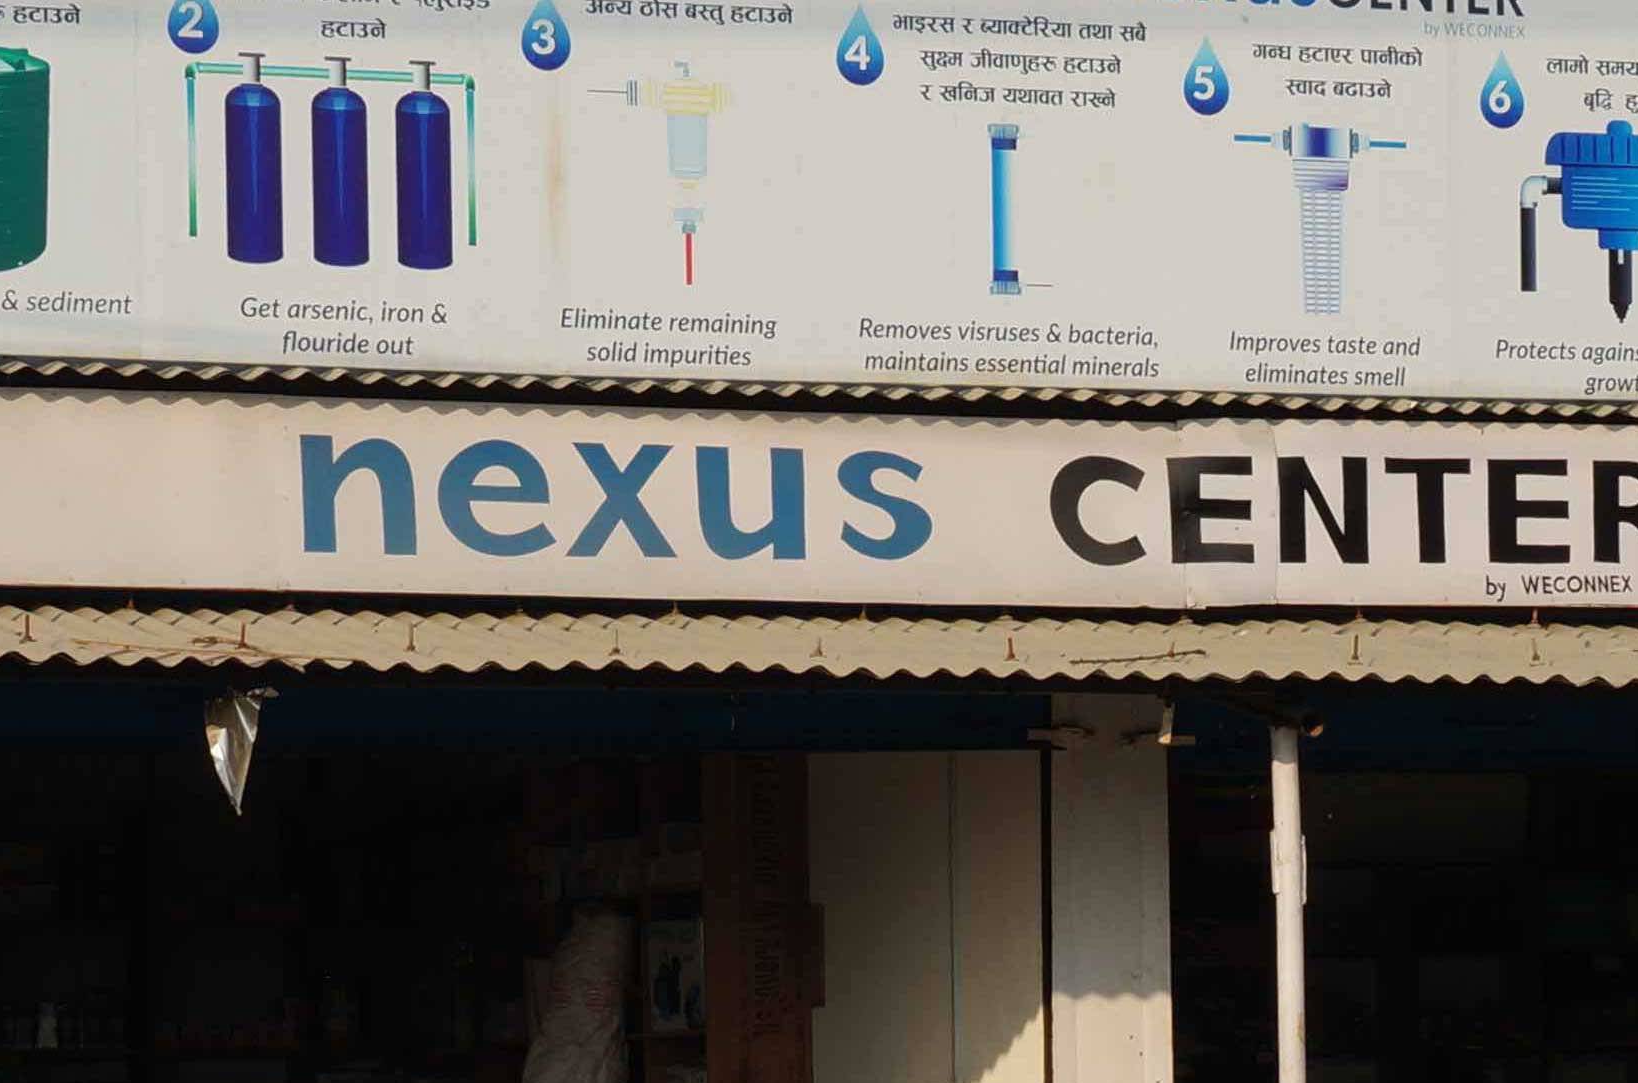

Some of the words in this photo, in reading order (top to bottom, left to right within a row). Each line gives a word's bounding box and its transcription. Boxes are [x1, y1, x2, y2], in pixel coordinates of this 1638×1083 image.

[13, 4, 80, 24] हटाउने
[178, 1, 205, 38] 2
[685, 3, 724, 25] बस्तु
[731, 4, 793, 24] हटाउने
[321, 18, 386, 38] हटाउने
[531, 19, 556, 55] 3
[893, 15, 955, 33] भाइरस
[963, 18, 974, 34] र
[1079, 24, 1113, 39] तथा
[1120, 22, 1147, 41] सबै
[1422, 21, 1440, 37] by
[1444, 22, 1524, 38] WECONNEX
[844, 35, 870, 70] 4
[1064, 55, 1121, 74] हटाउने
[1253, 44, 1291, 60] गन्ध
[1299, 47, 1352, 64] हटाएर
[1361, 46, 1422, 66] पानीको
[1547, 55, 1589, 74] लामो
[921, 85, 931, 100] र
[939, 81, 995, 102] खनिज
[1003, 89, 1063, 105] यथावत
[1192, 66, 1216, 100] 5
[1286, 80, 1326, 96] स्वाद
[1489, 79, 1511, 114] 6
[2, 290, 18, 310] &
[27, 291, 131, 314] sediment
[241, 297, 280, 318] Get
[288, 300, 373, 323] arsenic,
[382, 301, 423, 322] iron
[432, 304, 446, 323] &
[561, 308, 662, 330] Eliminate
[670, 313, 776, 339] remaining
[860, 318, 951, 340] Removes
[958, 321, 1039, 342] visruses
[1047, 323, 1060, 342] &
[1069, 324, 1158, 348] bacteria,
[283, 331, 368, 354] flouride
[377, 337, 413, 355] out
[587, 341, 637, 362] solid
[644, 343, 751, 368] impurities
[1230, 331, 1320, 355] Improves
[1328, 336, 1376, 354] taste
[1383, 337, 1420, 356] and
[1496, 339, 1576, 360] Protects
[865, 351, 968, 372] maintains
[976, 354, 1066, 374] essential
[1072, 356, 1159, 377] minerals
[1246, 362, 1347, 384] eliminates
[1355, 367, 1405, 386] smell
[298, 430, 934, 565] nexus
[1486, 576, 1505, 602] by
[1522, 576, 1632, 594] WECONNEX
